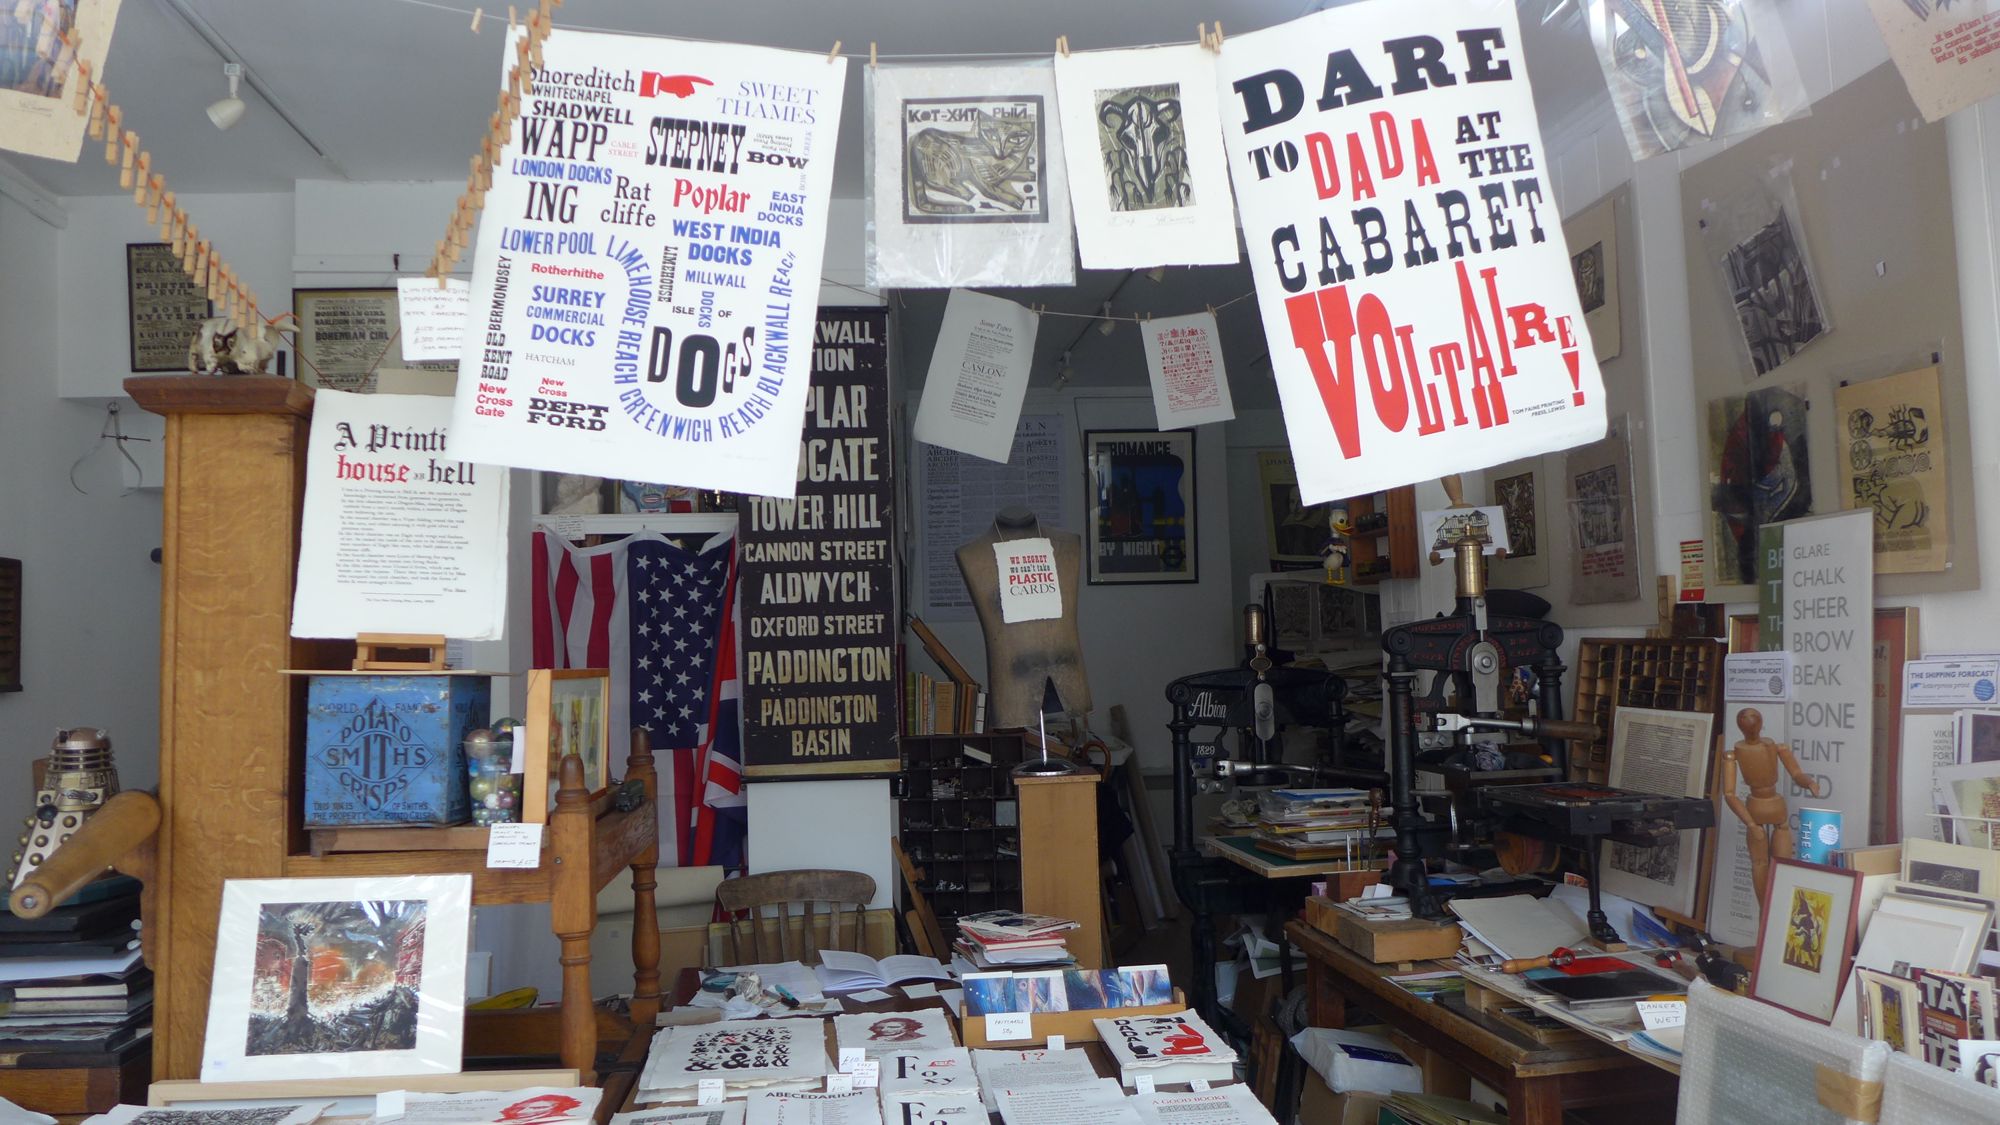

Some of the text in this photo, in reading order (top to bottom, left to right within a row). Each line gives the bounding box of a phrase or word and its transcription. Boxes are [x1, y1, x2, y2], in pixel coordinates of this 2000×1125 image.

[531, 83, 612, 104] WHITECHAPEL
[738, 80, 819, 106] SWEET
[1232, 27, 1513, 135] DARE
[532, 99, 634, 126] SHADWELL
[716, 96, 816, 124] THAMES
[520, 116, 608, 162] WAPP
[1455, 111, 1502, 145] AT
[645, 115, 746, 175] STEPNEY
[1304, 110, 1441, 201] DADA
[512, 158, 613, 185] LONDON DOCKS
[746, 150, 809, 170] BOW
[1248, 139, 1299, 181] TO
[1458, 143, 1534, 179] THE
[615, 175, 651, 202] Rat
[673, 178, 751, 214] Poplar
[772, 190, 806, 204] EAST
[523, 180, 578, 223] ING
[600, 201, 656, 227] cliffe
[769, 202, 805, 216] INDIA
[757, 211, 804, 228] DOCKS
[500, 227, 597, 256] LOWER POOL
[672, 219, 781, 249] WEST INDIA
[1271, 177, 1546, 293] CABARET
[688, 242, 752, 267] DOCKS
[531, 262, 605, 281] Rotherhithe
[657, 245, 679, 303] LIMEHOUSE
[685, 269, 747, 289] MILLWALL
[490, 254, 513, 331] BERMONDSEY
[531, 284, 606, 309] SURREY
[526, 305, 605, 327] COMMERCIAL
[606, 235, 653, 385] LIMEHOUSE REACH
[672, 305, 733, 319] ISLE OF
[698, 290, 714, 329] DOCKS
[530, 323, 596, 347] DOCKS
[757, 249, 797, 400] BLACKWALL REACH
[486, 332, 507, 347] OLD
[483, 349, 513, 365] KENT
[524, 352, 576, 367] HATCHAM
[647, 325, 756, 408] DOGS
[812, 348, 855, 372] ION
[1284, 260, 1586, 460] VOLTAIRE!
[481, 364, 509, 381] ROAD
[541, 377, 565, 388] New
[476, 394, 513, 408] Cross
[478, 383, 507, 395] New
[538, 386, 568, 397] Cross
[475, 405, 506, 418] Gate
[526, 411, 608, 432] FORD
[529, 396, 609, 422] DEPT
[619, 387, 775, 443] GREENWICH REACH
[333, 421, 358, 451] A
[336, 454, 476, 485] house hell
[749, 494, 882, 531] TOWER HILL
[745, 540, 887, 563] CANNON STREET
[1010, 555, 1048, 565] WE REGRET
[1793, 543, 1831, 560] GLARE
[1009, 572, 1054, 585] PLASTIC
[1010, 563, 1051, 574] we can't take
[1793, 567, 1845, 588] CHALK
[760, 571, 871, 605] ALDWYCH
[1009, 583, 1056, 597] CARDS
[1793, 596, 1849, 620] SHEER
[750, 614, 885, 638] OXFORD STREET
[1793, 629, 1854, 653] BROW
[748, 646, 892, 687] PADDINGTON
[1793, 664, 1841, 687] BEAK
[1958, 670, 1995, 678] FORECAST
[761, 694, 878, 727] PADDINGTON
[1188, 691, 1227, 720] Albion
[1791, 702, 1855, 729] BONE
[341, 697, 411, 743] POTATO
[792, 728, 852, 757] BASIN
[1196, 745, 1216, 756] 1829
[1791, 740, 1845, 763] FLINT
[326, 733, 427, 781] SMITH'S
[340, 772, 408, 812] CRISPS
[1654, 1016, 1681, 1025] WET
[765, 1091, 863, 1100] ABECEDARIUM
